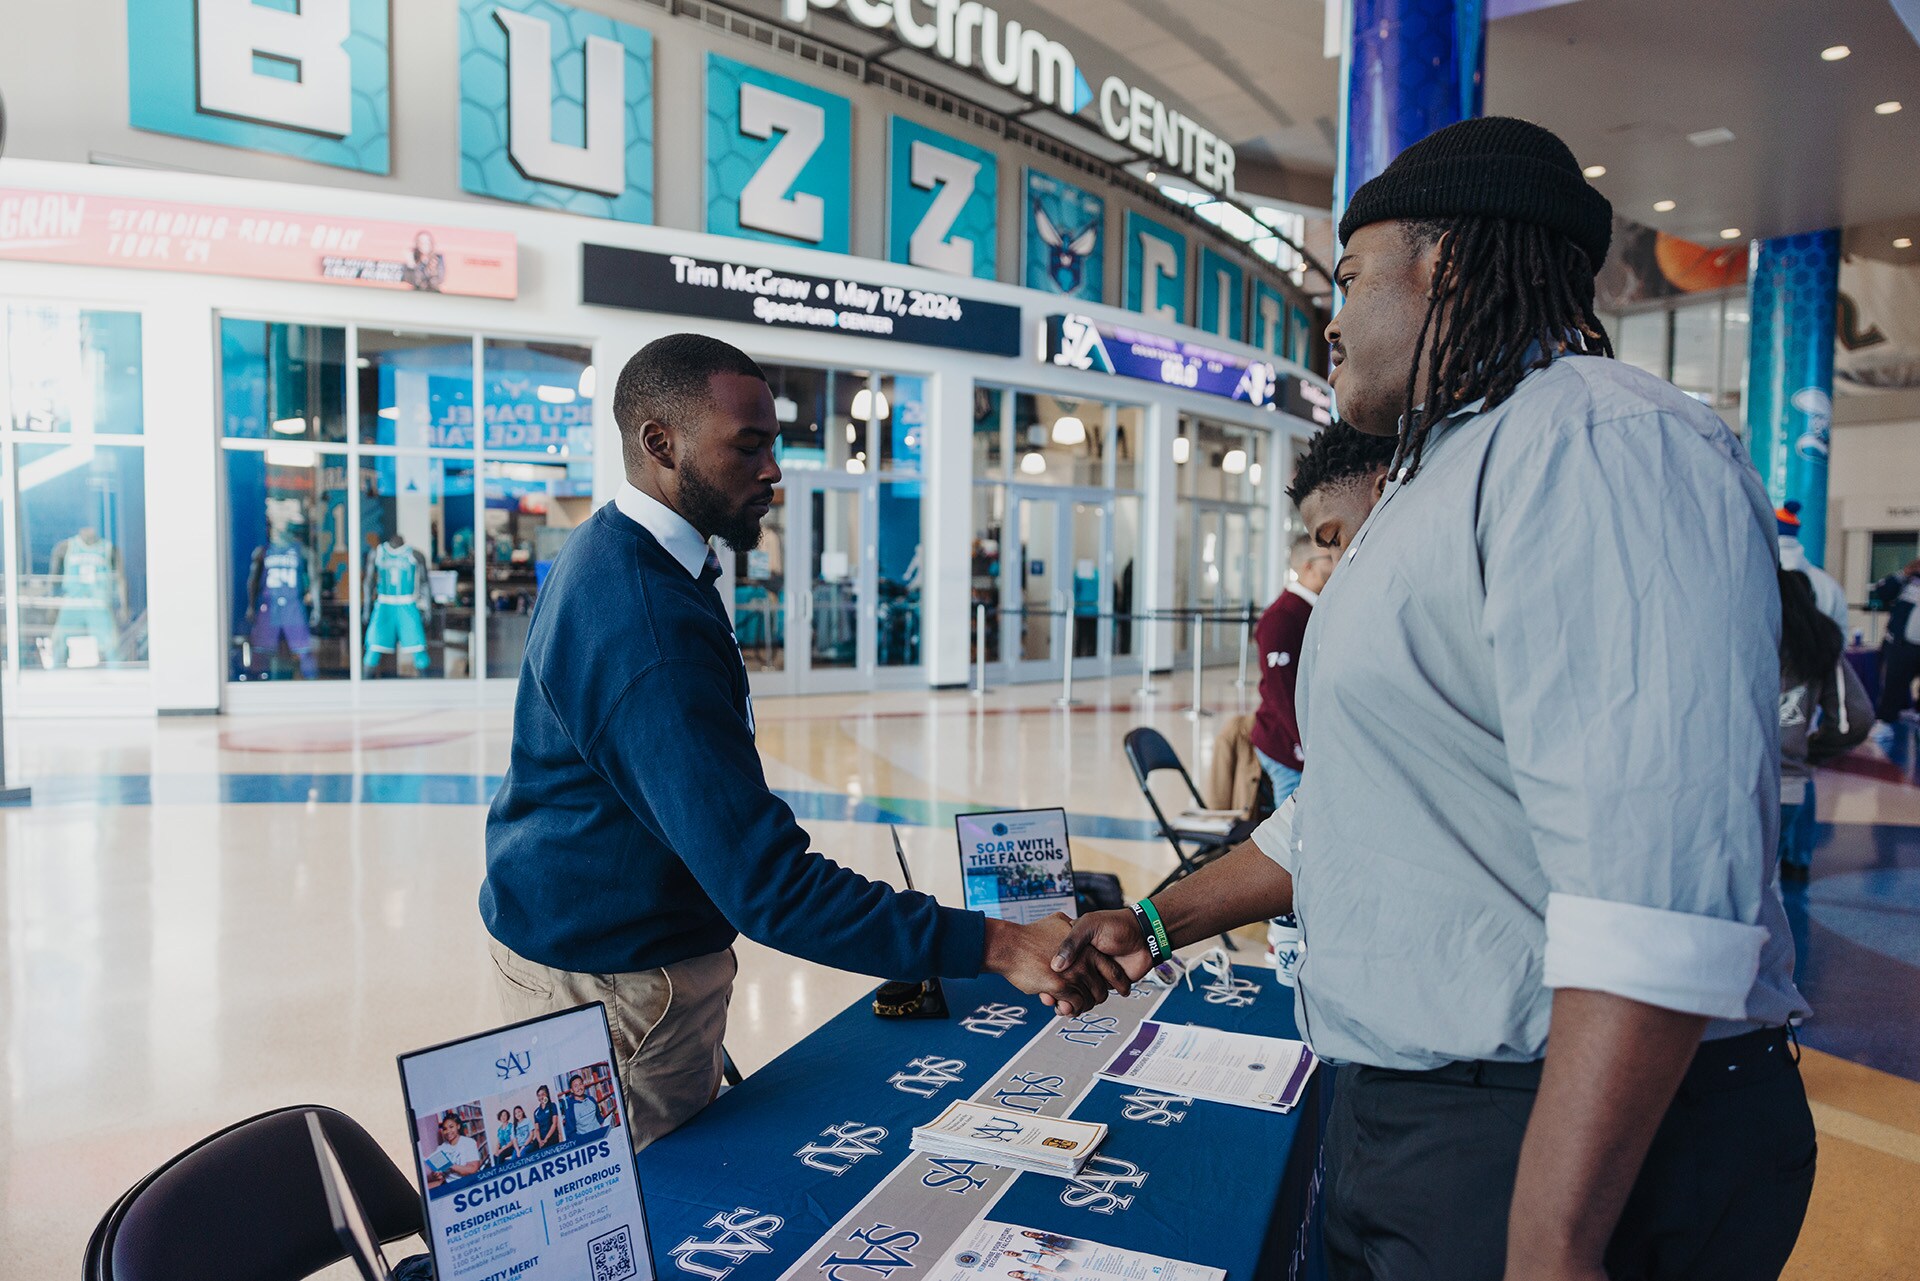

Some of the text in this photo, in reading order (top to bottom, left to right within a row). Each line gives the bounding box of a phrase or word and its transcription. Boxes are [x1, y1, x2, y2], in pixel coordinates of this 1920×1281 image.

[1100, 76, 1236, 195] CENTER
[107, 209, 229, 239] STANDING
[107, 232, 172, 260] TOUR
[670, 256, 718, 288] Tim
[722, 263, 811, 299] McGraw
[834, 280, 880, 314] May
[908, 290, 963, 322] 2024
[753, 297, 894, 335] Spectrum CENTER
[970, 848, 1064, 866] THE FALCONS
[976, 838, 1054, 854] SOAR WITH
[1147, 935, 1160, 958] TRIO
[958, 1002, 1028, 1039] SAU
[495, 1051, 531, 1079] SAU
[886, 1054, 967, 1099] SAU
[992, 1071, 1066, 1115] SAU
[971, 1116, 1024, 1142] SAU
[477, 1140, 577, 1180] SAINT AUGUSTINE'S UNIVERSITY
[793, 1120, 889, 1177] SAU
[453, 1141, 611, 1213] SCHOLARSHIPS
[554, 1163, 622, 1198] MERITORIOUS
[555, 1199, 564, 1207] UP
[594, 1182, 604, 1191] PER
[605, 1176, 619, 1186] YEAR
[921, 1156, 1001, 1195] SA
[1060, 1152, 1149, 1215] SAU
[445, 1200, 522, 1237] PRESIDENTIAL
[447, 1206, 533, 1245] FULL COST OF ATTENDANCE
[597, 1205, 608, 1214] ACT
[495, 1242, 509, 1252] ACT
[667, 1206, 785, 1281] SAU
[479, 1256, 539, 1281] SITY MERIT
